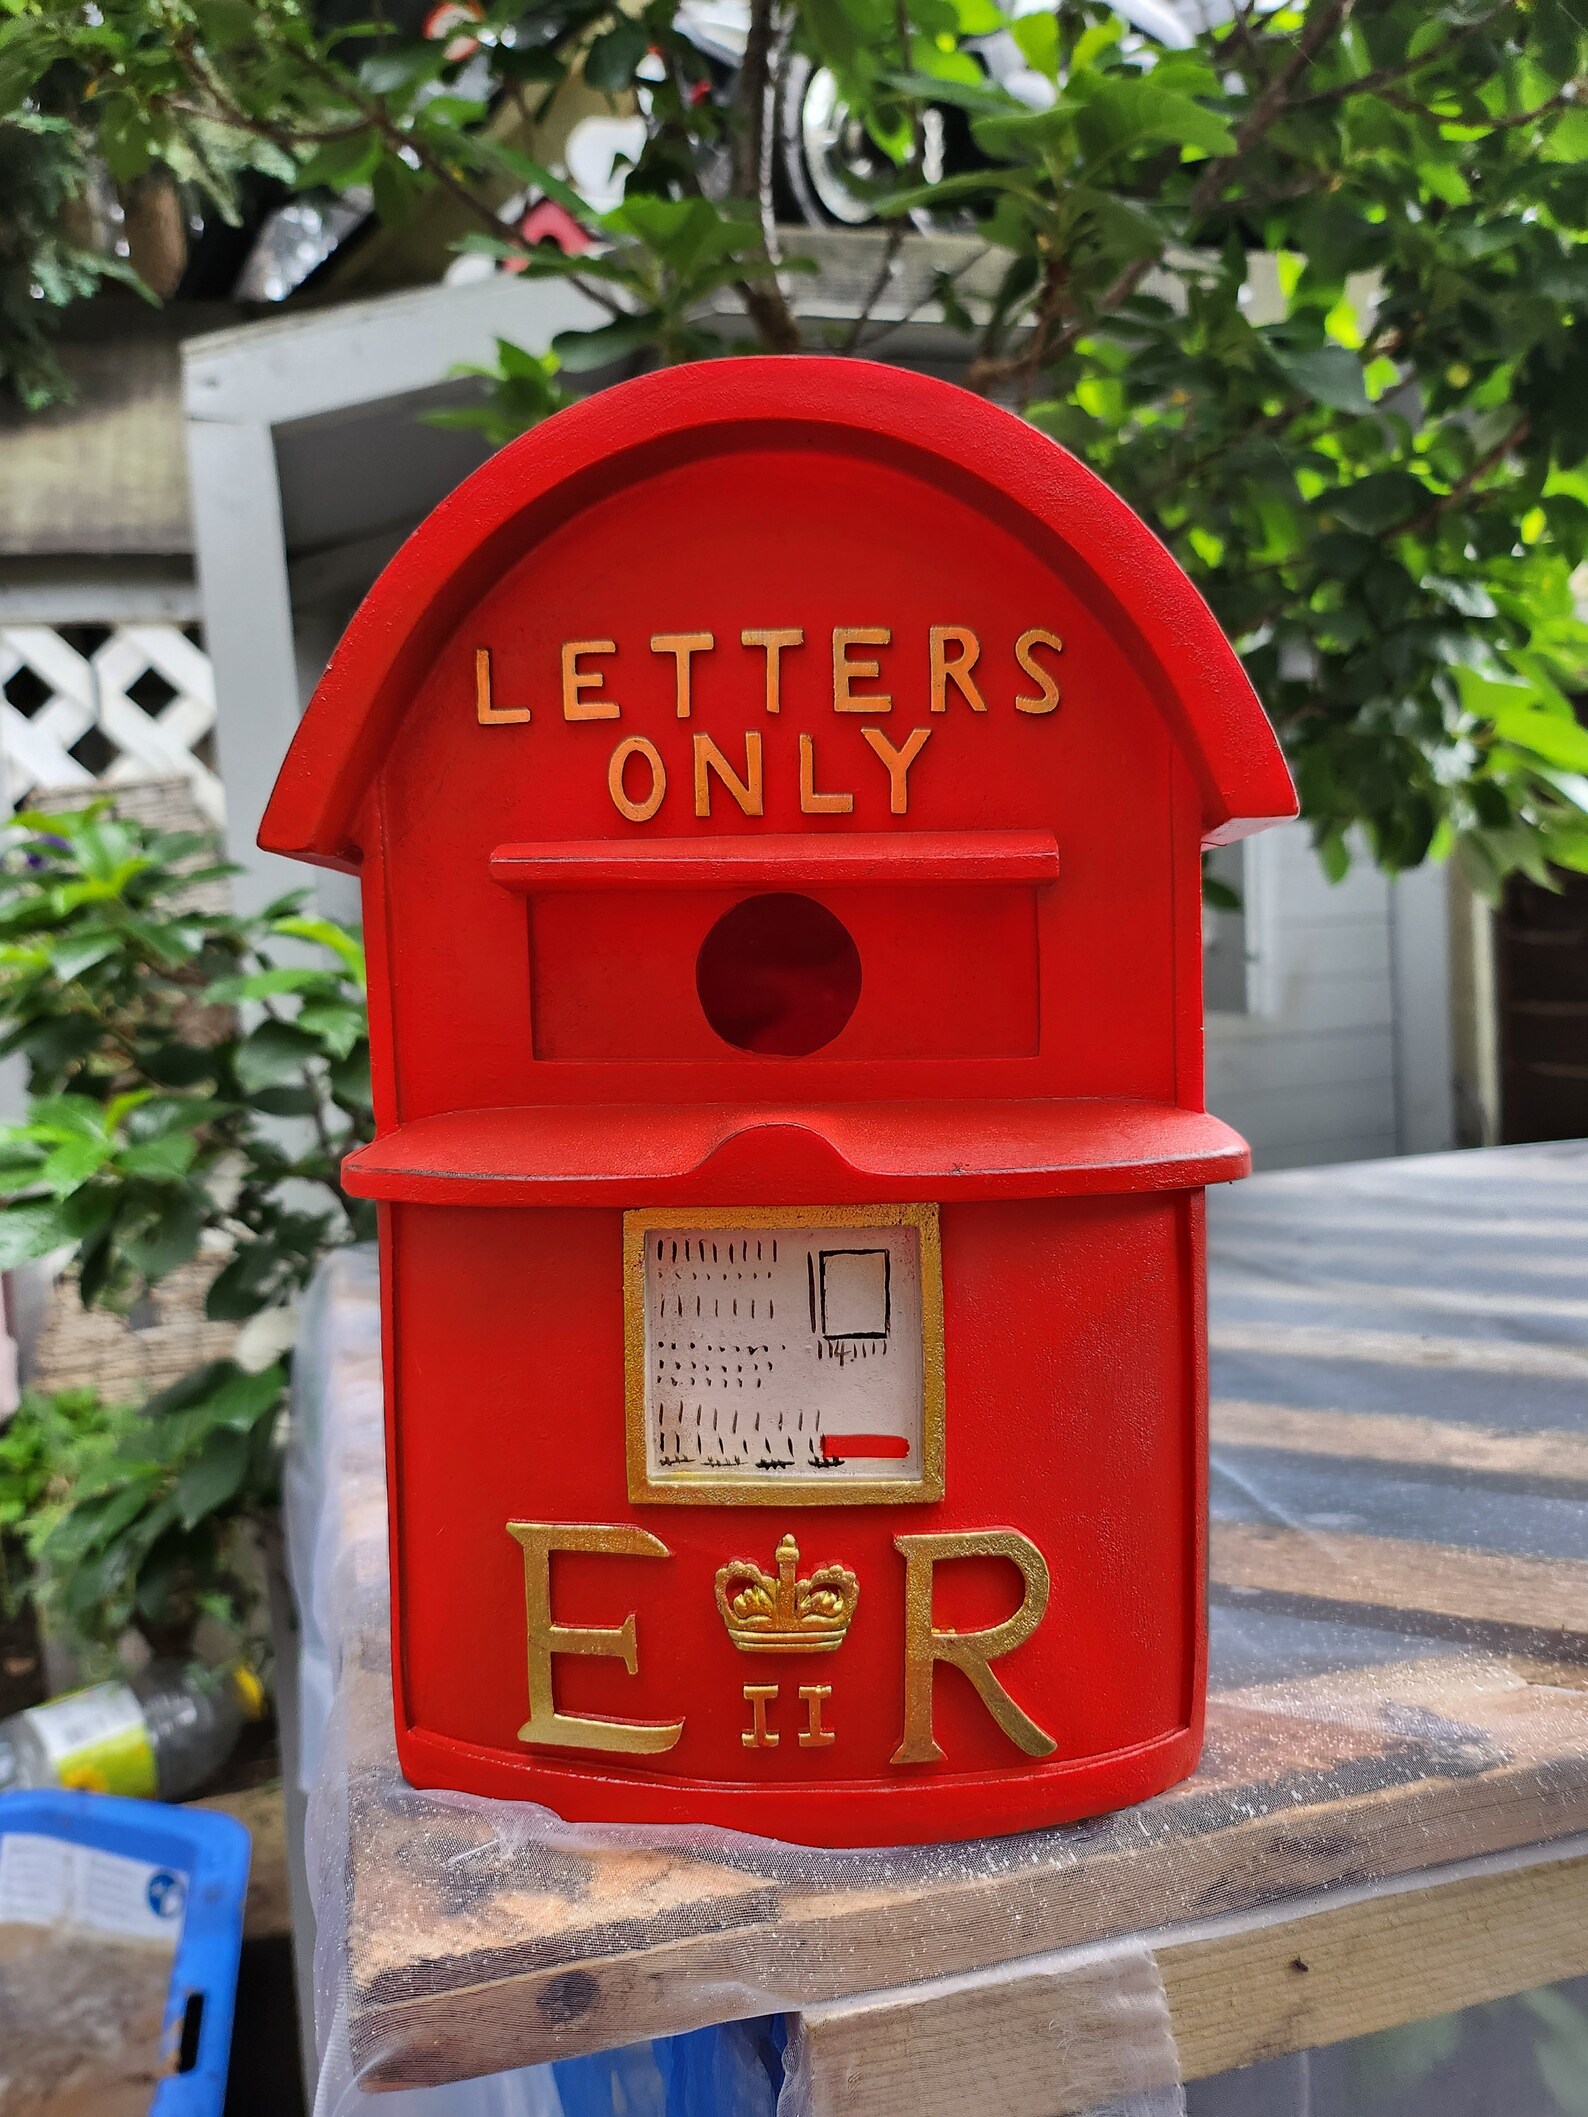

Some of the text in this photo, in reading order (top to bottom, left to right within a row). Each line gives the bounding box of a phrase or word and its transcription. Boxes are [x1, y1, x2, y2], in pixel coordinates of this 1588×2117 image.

[475, 625, 1064, 725] LETTERS
[607, 727, 932, 822] ONLY
[505, 1520, 1058, 1765] E R
[740, 1682, 836, 1748] II
